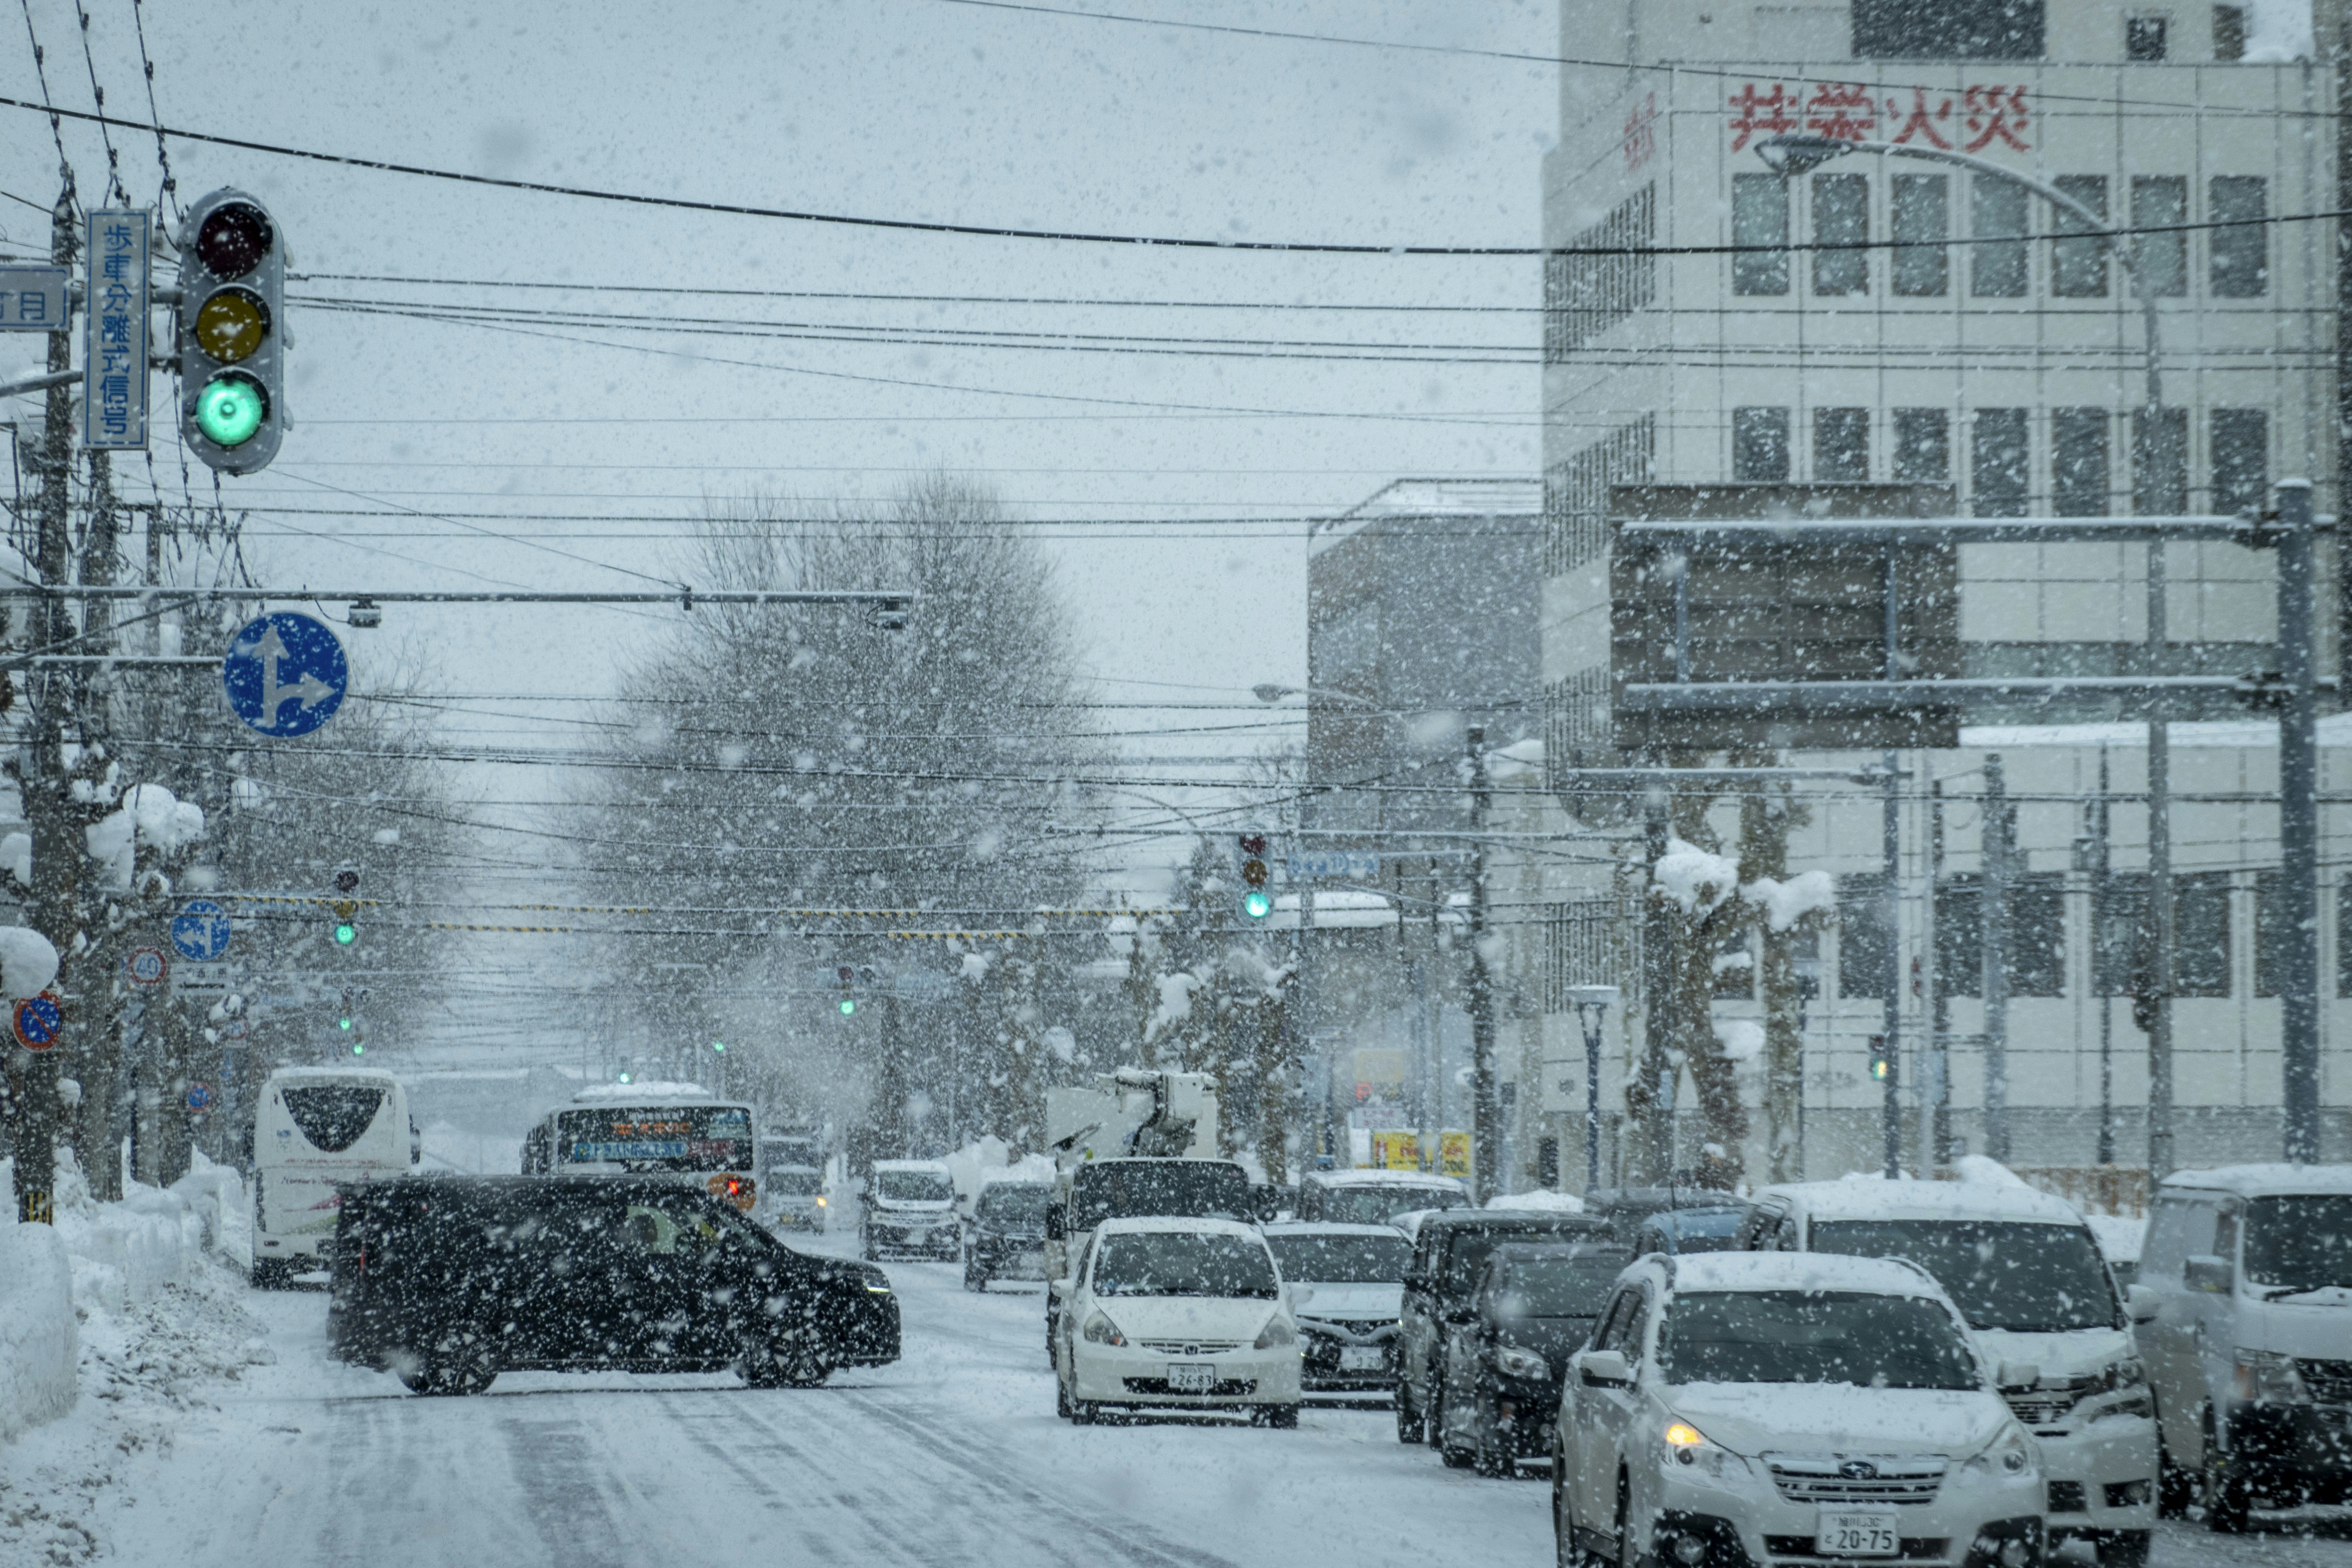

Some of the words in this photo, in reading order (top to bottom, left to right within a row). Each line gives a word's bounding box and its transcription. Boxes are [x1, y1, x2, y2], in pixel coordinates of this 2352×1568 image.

[1728, 83, 2031, 153] 共栄火災
[99, 224, 132, 435] 歩車分離式信号
[1178, 1374, 1211, 1387] 26-83
[1837, 1529, 1892, 1550] 20-75
